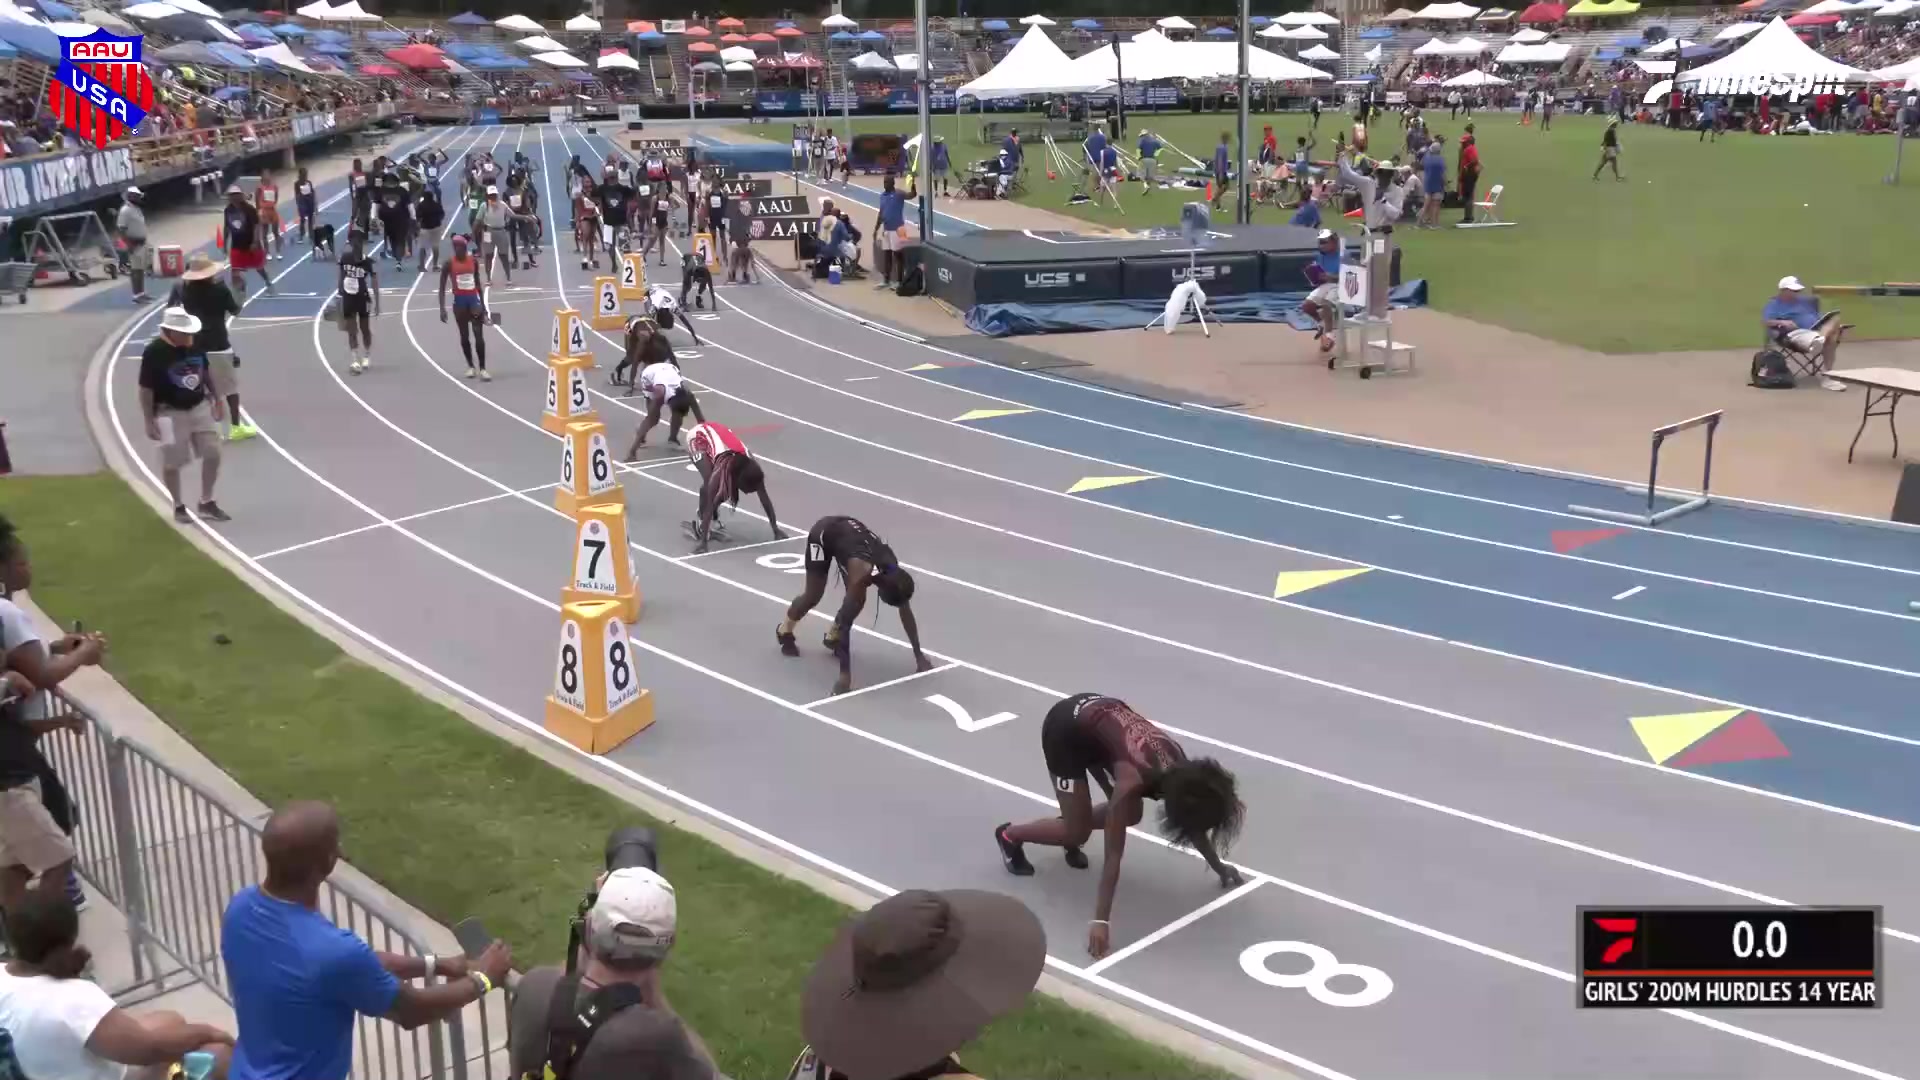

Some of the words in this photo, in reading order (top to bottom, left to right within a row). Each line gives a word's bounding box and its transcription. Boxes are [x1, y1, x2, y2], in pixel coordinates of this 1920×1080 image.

[649, 141, 672, 149] AAU
[757, 199, 793, 214] AAU
[625, 266, 633, 283] 2
[1025, 272, 1070, 288] UCS
[1171, 265, 1216, 281] UCS
[603, 291, 616, 311] 3
[571, 326, 582, 348] 4
[548, 380, 556, 407] 5
[572, 380, 585, 407] 5
[563, 448, 573, 483] 6
[592, 448, 608, 481] 6
[583, 539, 606, 579] 7
[812, 545, 821, 559] 7
[576, 580, 592, 589] Track
[600, 582, 615, 592] Field
[561, 643, 577, 694] 8
[610, 640, 630, 691] 8
[923, 693, 1020, 732] 7
[1239, 940, 1394, 1008] 8
